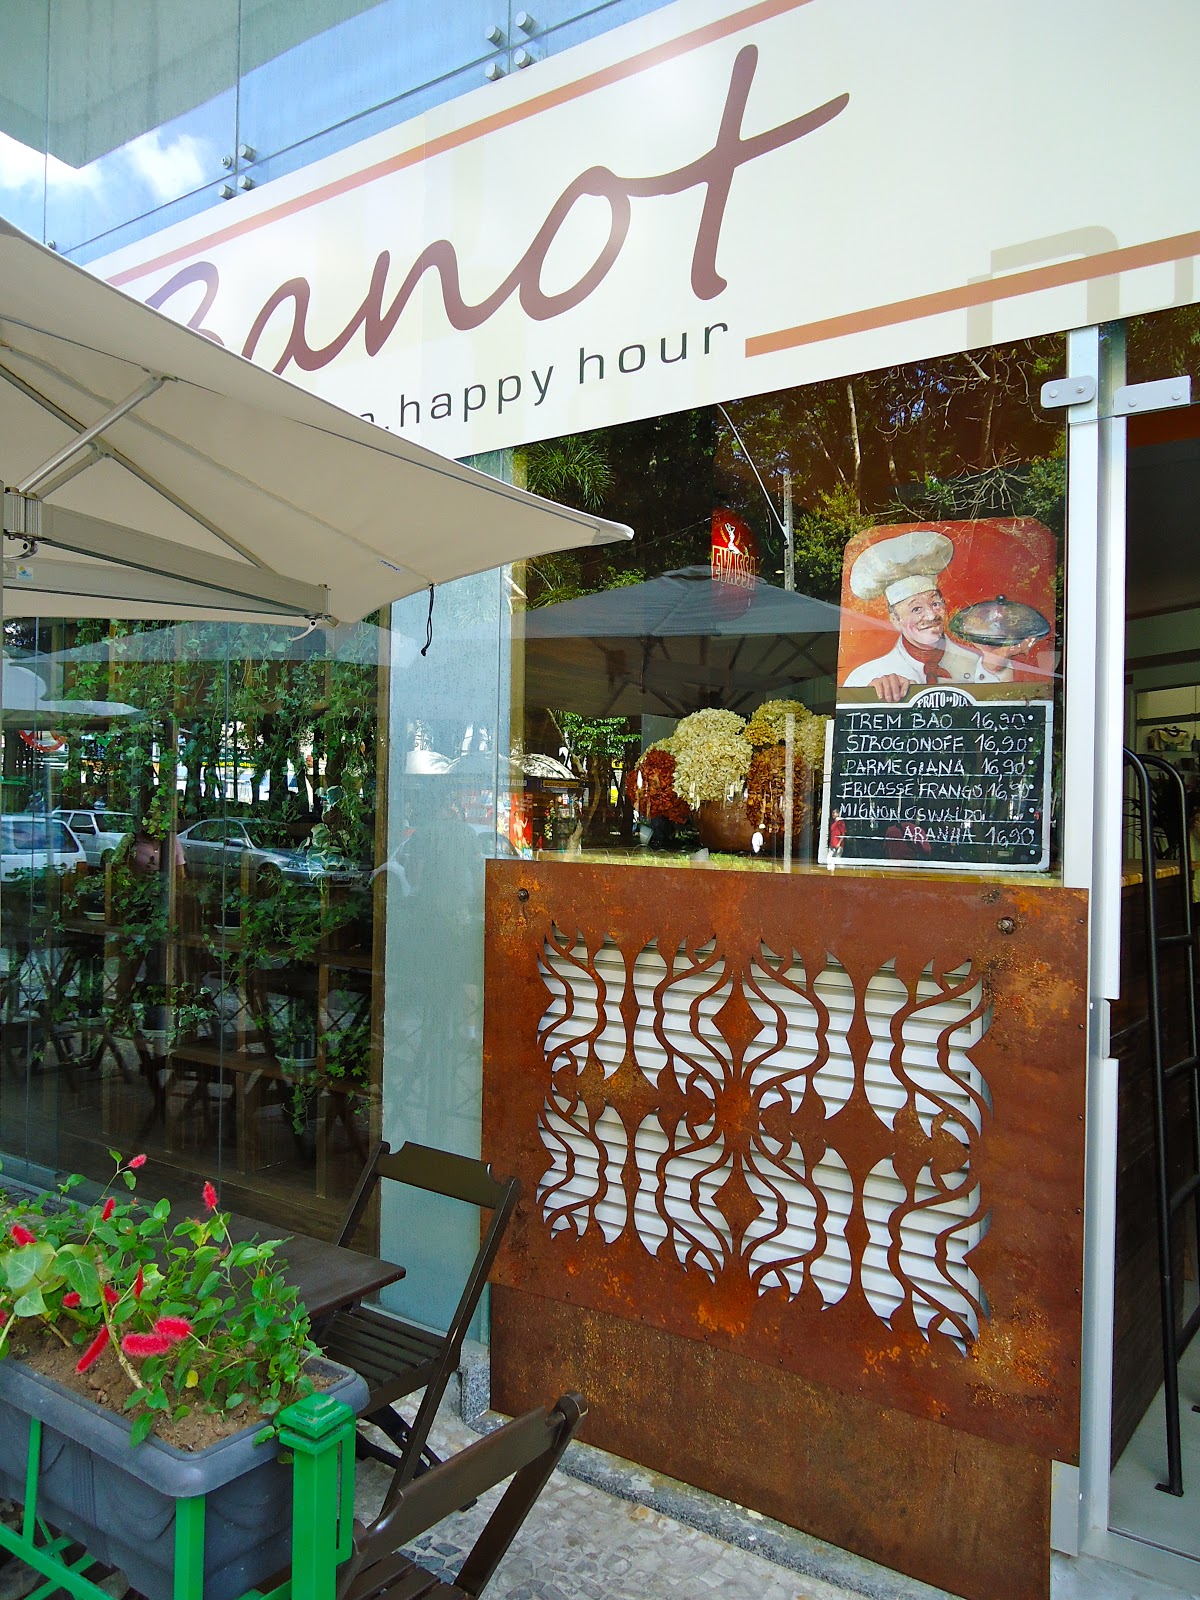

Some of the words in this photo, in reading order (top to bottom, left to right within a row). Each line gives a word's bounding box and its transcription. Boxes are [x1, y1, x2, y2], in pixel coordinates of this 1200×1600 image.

[579, 322, 729, 384] hour
[916, 691, 946, 708] PRATO
[952, 692, 970, 708] DIA
[846, 712, 902, 731] TREM
[970, 711, 1026, 732] 16,90
[846, 734, 964, 754] STROGONOFF
[975, 733, 1027, 755] 16,90
[981, 757, 1026, 783] 16,90
[919, 782, 983, 801] FRANGO
[839, 802, 901, 822] MIGNON
[903, 825, 976, 845] ARANHA
